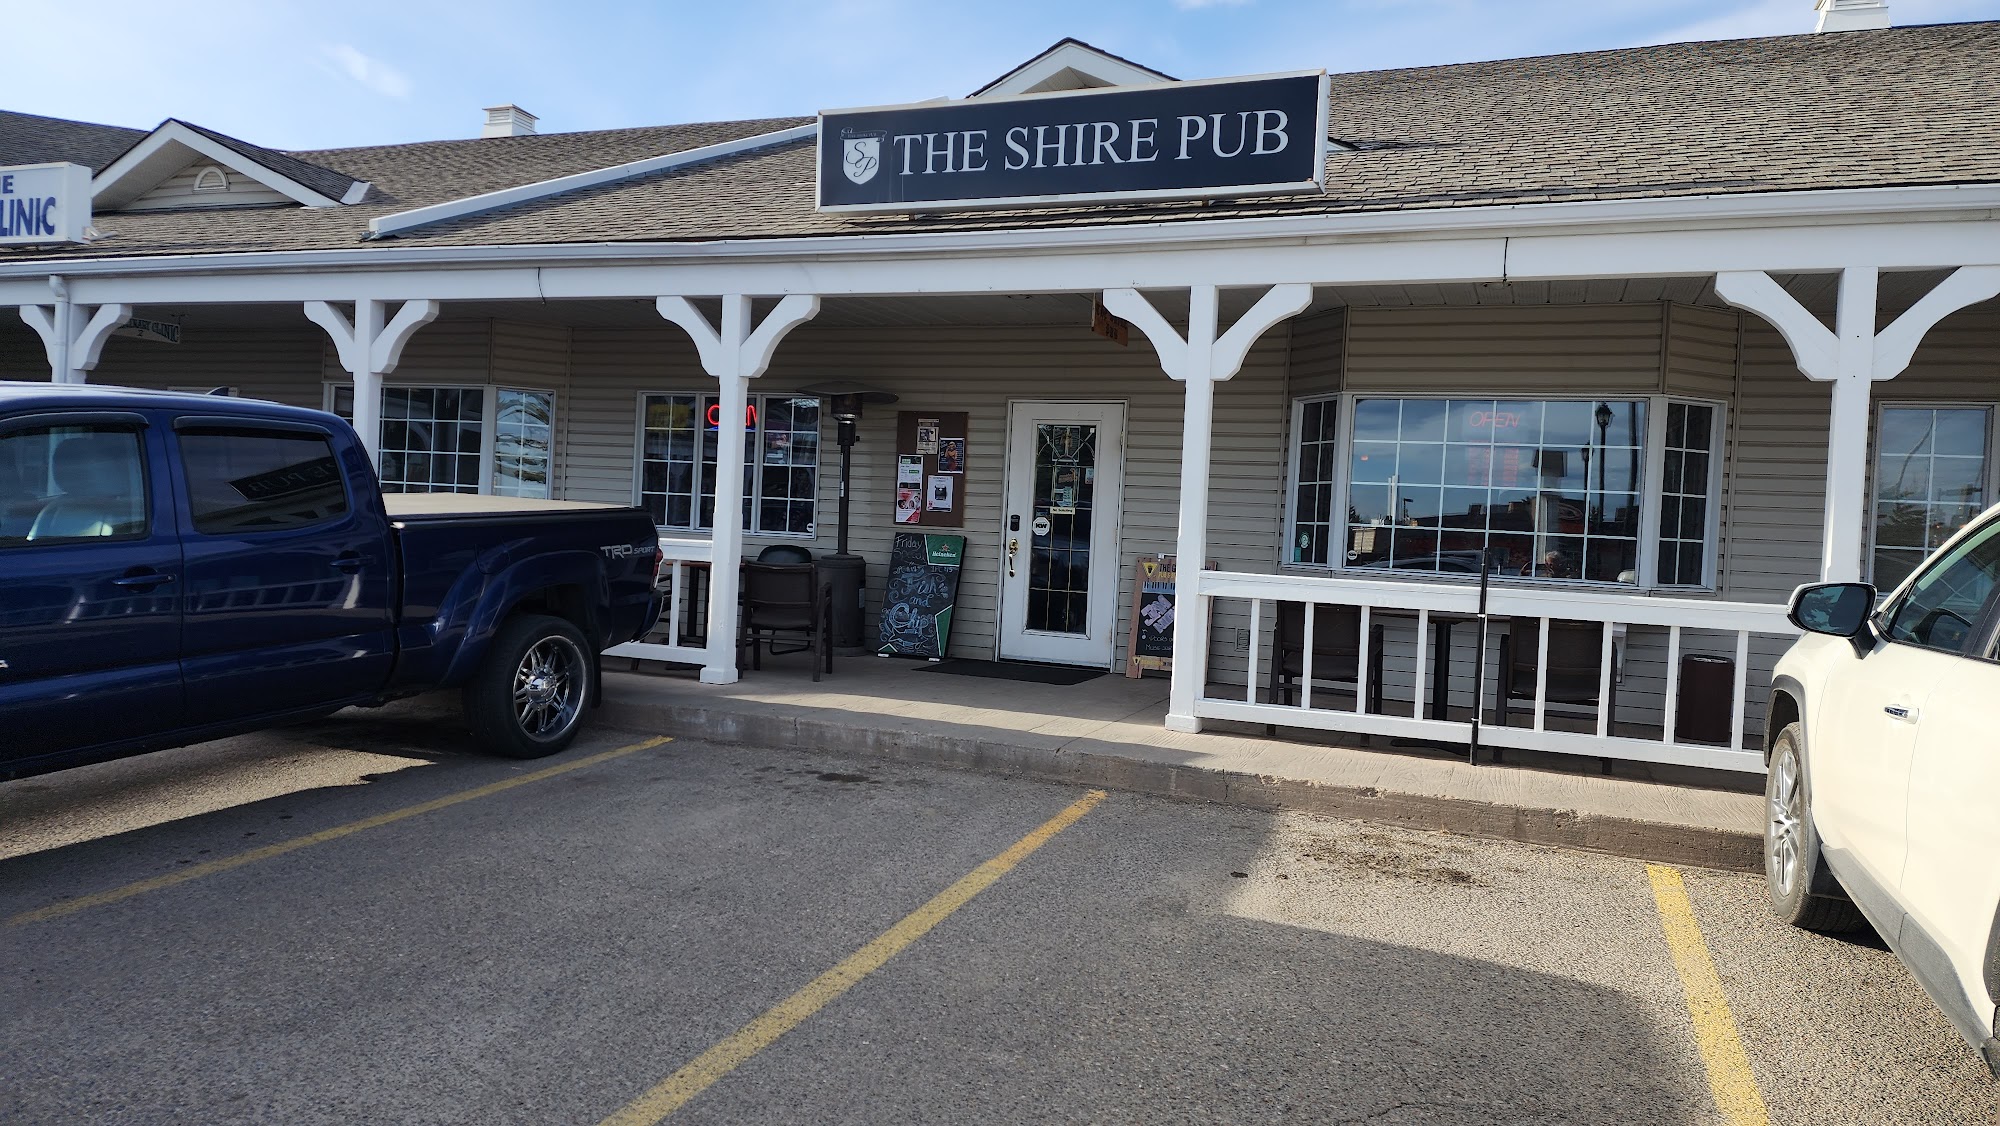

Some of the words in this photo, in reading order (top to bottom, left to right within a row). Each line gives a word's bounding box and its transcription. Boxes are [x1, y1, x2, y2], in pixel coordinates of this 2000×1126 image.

[893, 129, 989, 176] THE
[1004, 118, 1159, 171] SHIRE
[1173, 109, 1290, 162] PUB
[0, 196, 56, 237] LINIC
[1470, 411, 1520, 428] OPEN
[895, 534, 924, 550] Friday
[600, 543, 633, 560] TRD
[633, 546, 656, 555] SPORT
[1159, 563, 1171, 573] THE
[909, 595, 934, 608] and
